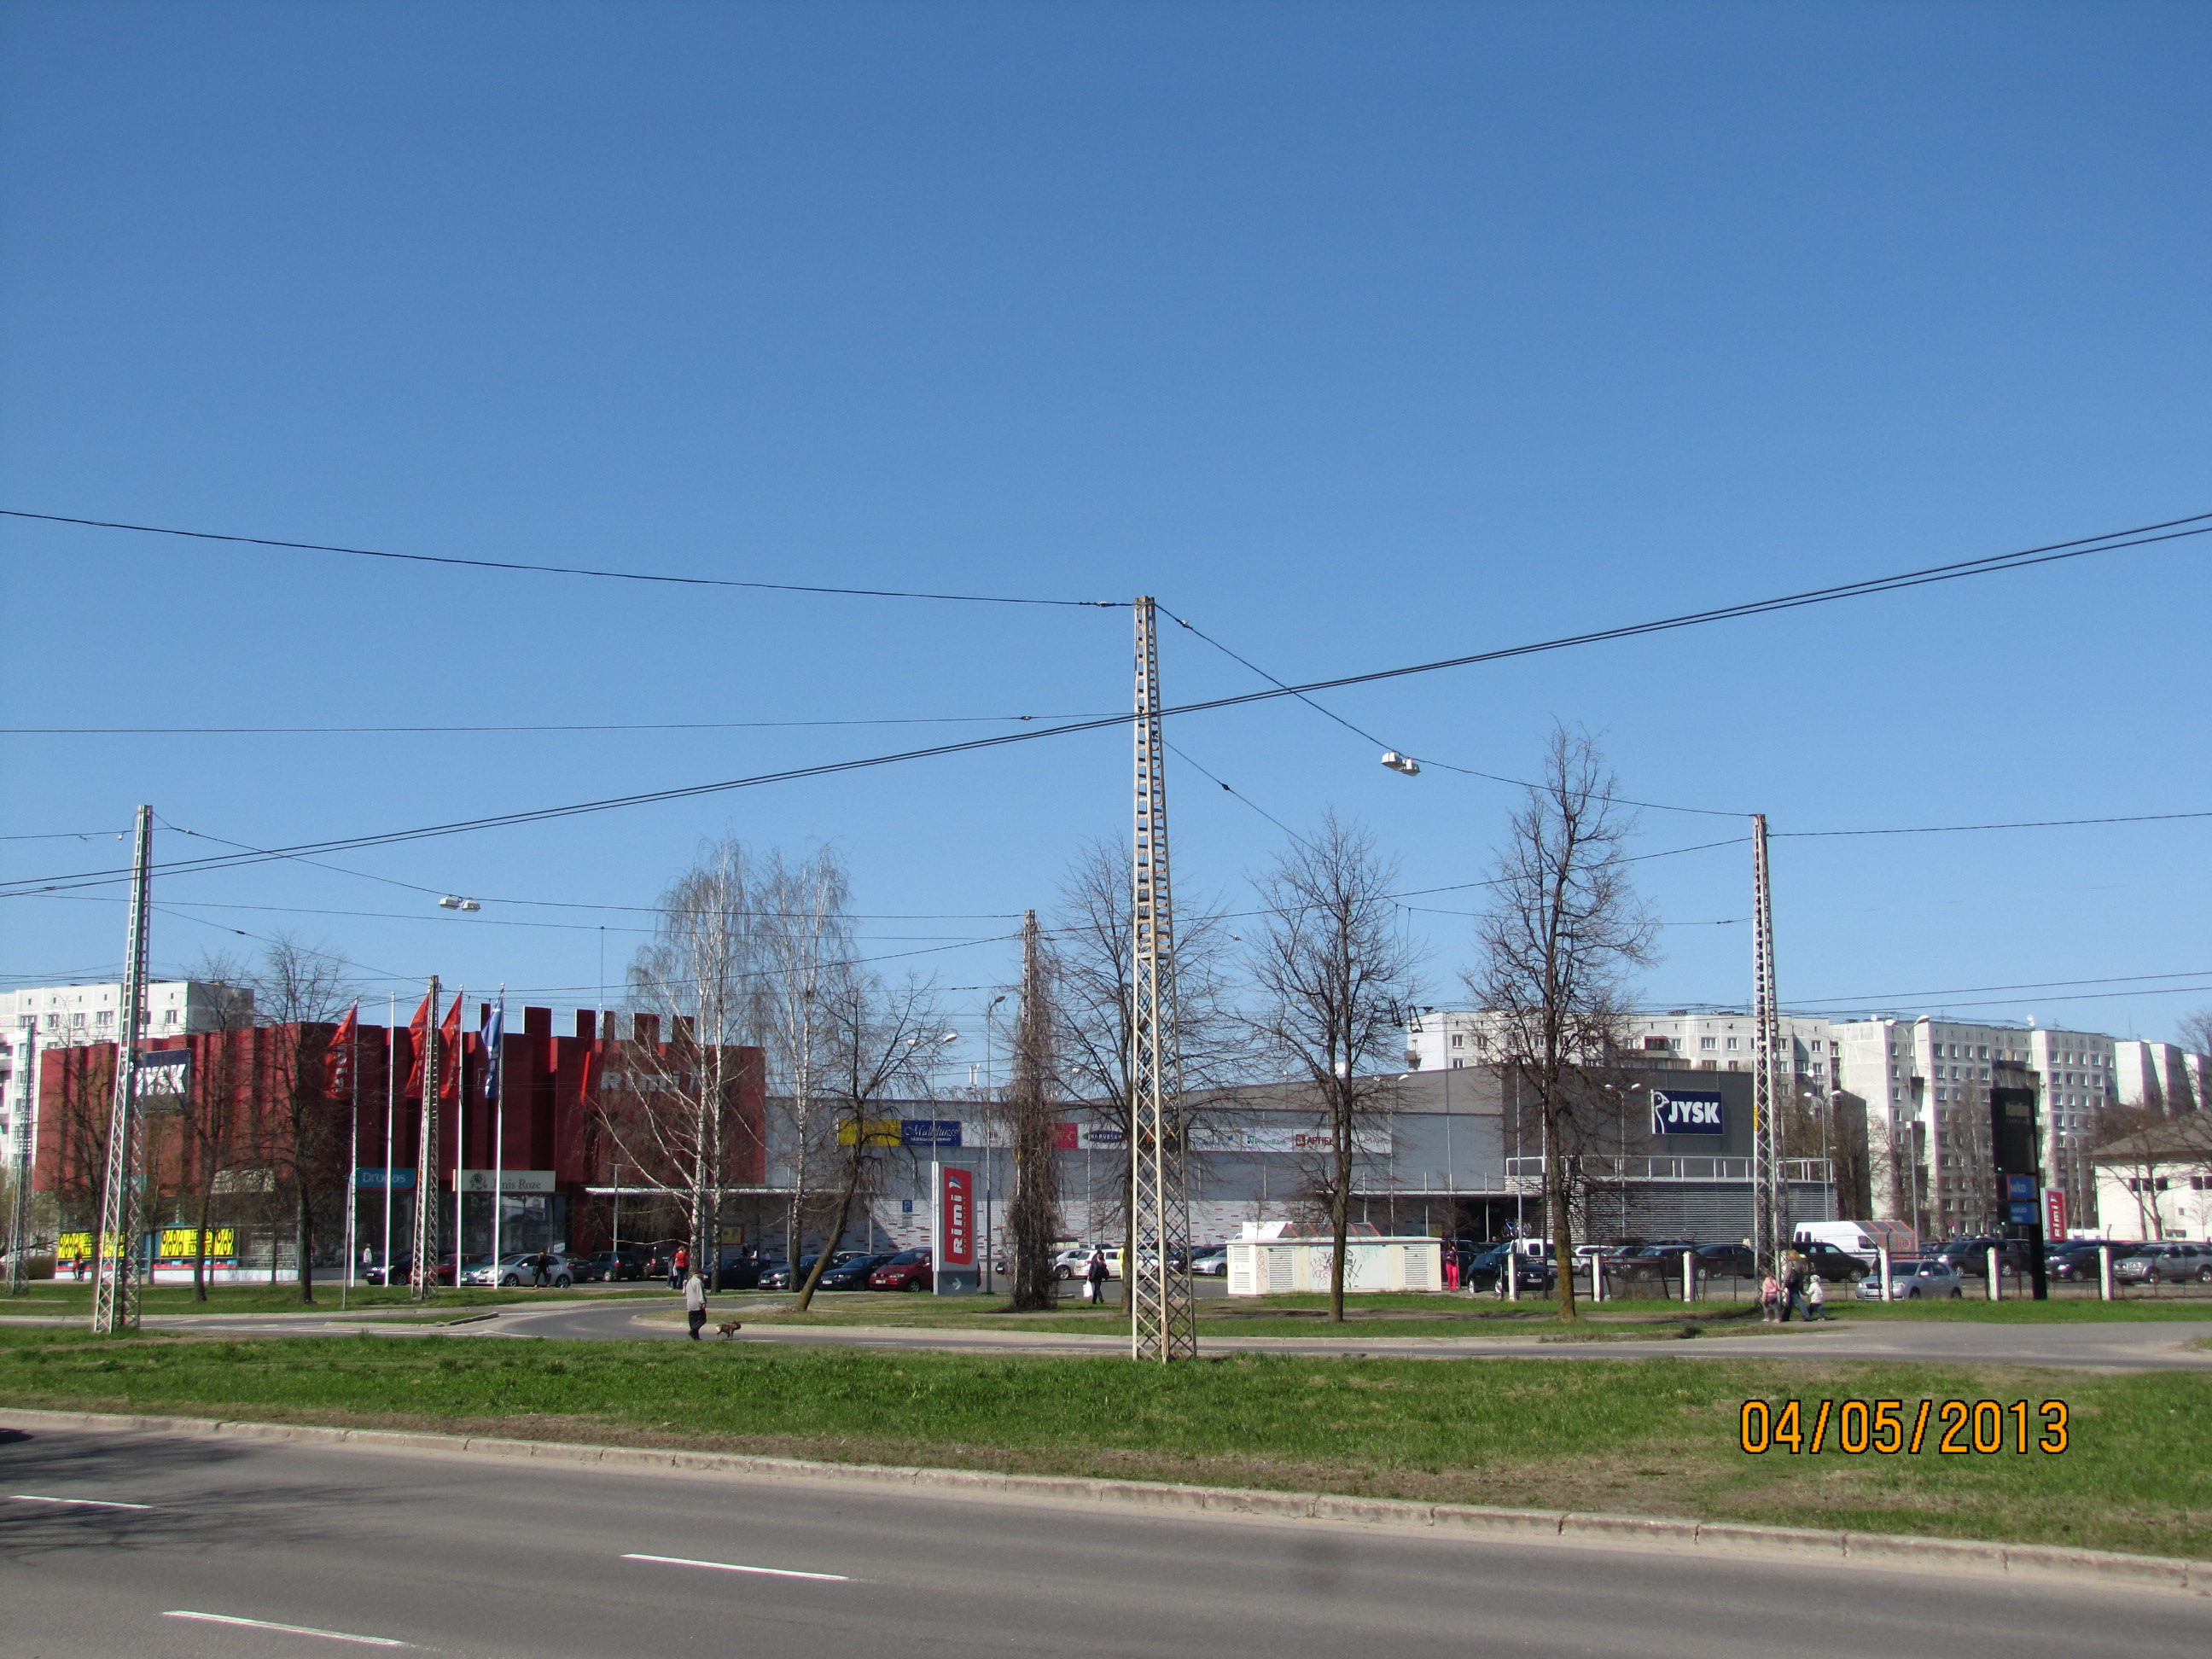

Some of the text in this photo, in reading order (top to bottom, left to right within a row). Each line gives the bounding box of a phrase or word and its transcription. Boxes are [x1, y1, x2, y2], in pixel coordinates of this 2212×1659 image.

[1668, 1101, 1720, 1123] JYSK
[492, 1179, 541, 1190] Jnis Roze
[951, 1194, 963, 1254] Rimi
[2051, 1204, 2061, 1237] Rimi
